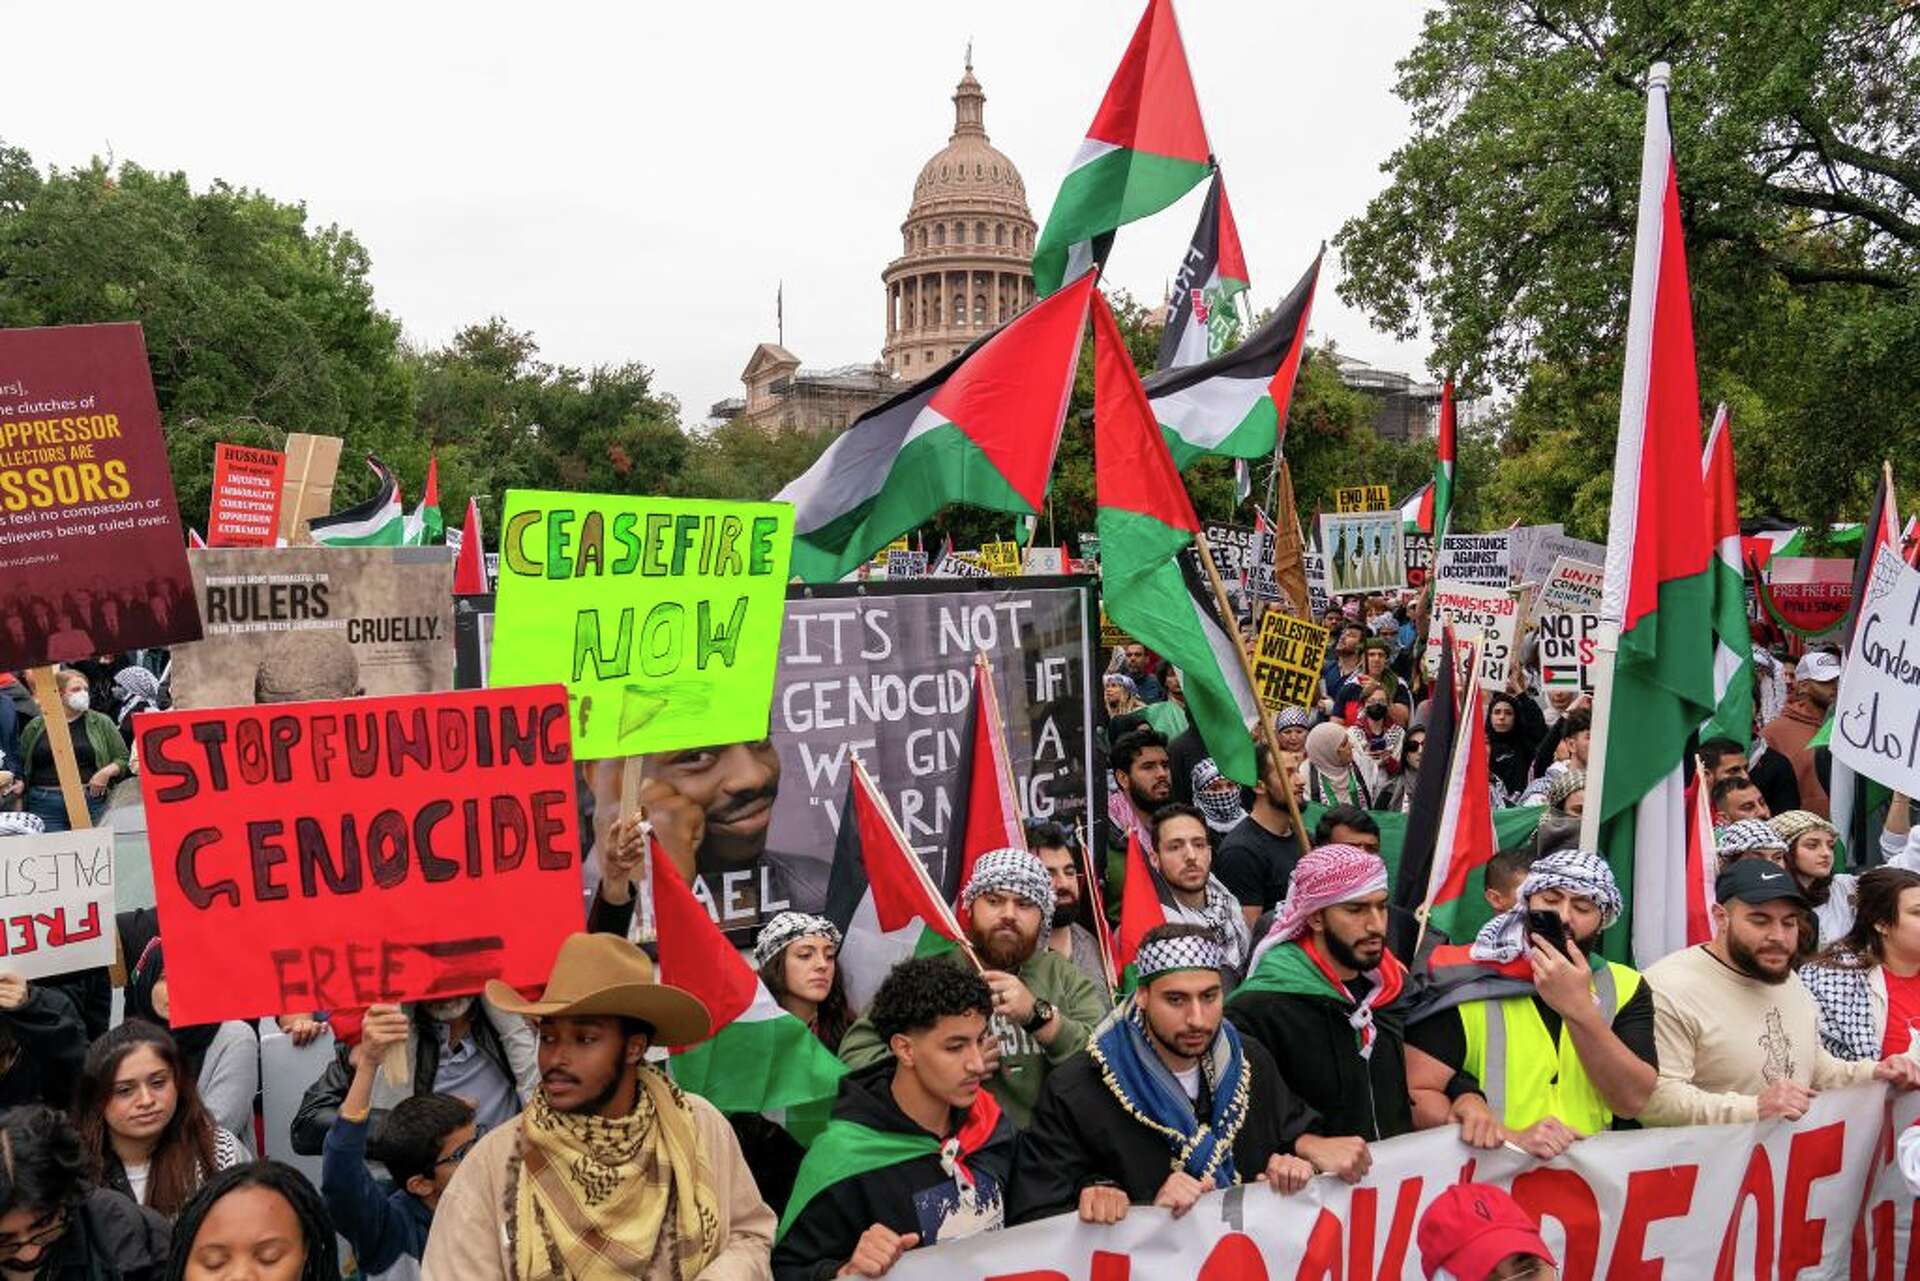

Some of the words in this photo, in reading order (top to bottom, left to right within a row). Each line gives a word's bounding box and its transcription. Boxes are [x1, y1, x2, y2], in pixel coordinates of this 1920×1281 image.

[18, 399, 78, 413] clutches
[79, 395, 95, 408] of
[70, 444, 95, 460] ARE
[224, 448, 278, 466] HUSSAIN
[0, 459, 131, 512] SSORS
[1340, 490, 1361, 505] END
[1366, 487, 1386, 502] ALL
[10, 511, 37, 525] feel
[40, 509, 59, 521] no
[62, 500, 143, 520] compassion
[146, 498, 161, 509] or
[57, 520, 96, 537] being
[99, 517, 134, 531] ruled
[138, 515, 170, 526] over.
[504, 510, 778, 579] CEASEFIRE
[1443, 537, 1508, 550] RESISTANCE
[1453, 551, 1498, 563] AGAINST
[1443, 565, 1508, 578] OCCUPATION
[206, 583, 329, 623] RULERS
[347, 616, 442, 644] CRUELLY.
[572, 596, 749, 683] NOW
[785, 608, 891, 664] IT'S
[940, 601, 1031, 655] NOT
[1265, 615, 1327, 648] PALESTINE
[1540, 614, 1574, 639] NO
[1262, 633, 1298, 665] WILL
[1300, 645, 1321, 671] BE
[1544, 639, 1576, 657] ON
[782, 664, 994, 733] GENOCID
[1035, 656, 1066, 702] IF
[1255, 660, 1314, 707] FREE!
[1034, 715, 1065, 760] A
[175, 790, 572, 910] GENOCIDE
[270, 940, 407, 1012] FREE
